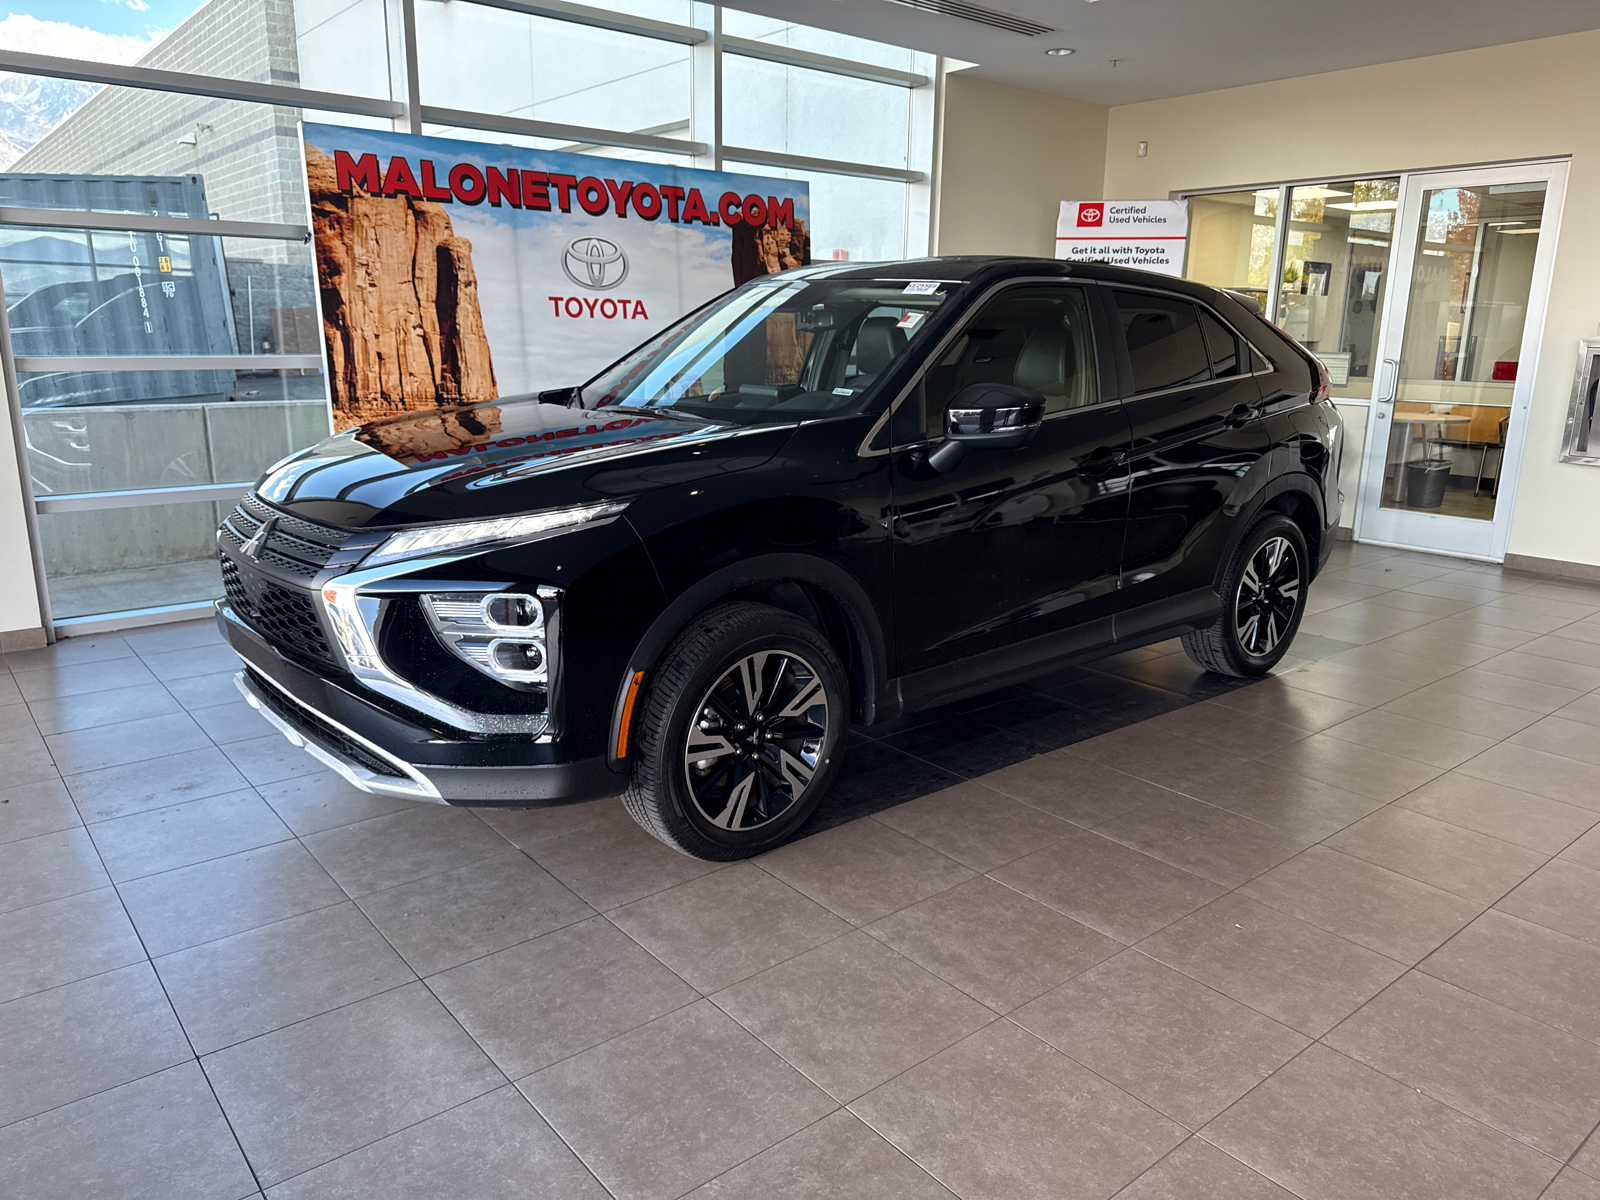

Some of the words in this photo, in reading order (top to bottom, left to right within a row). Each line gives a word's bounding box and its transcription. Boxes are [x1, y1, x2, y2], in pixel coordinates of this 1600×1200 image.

[334, 150, 794, 231] MALONETOYOTA.COM
[1109, 206, 1147, 214] Certified
[1090, 246, 1097, 254] it
[1098, 246, 1110, 254] all
[1112, 246, 1133, 254] with
[1134, 246, 1165, 256] Toyota
[1107, 256, 1130, 264] Used
[1132, 256, 1169, 264] Vehicles
[548, 296, 649, 320] TOYOTA
